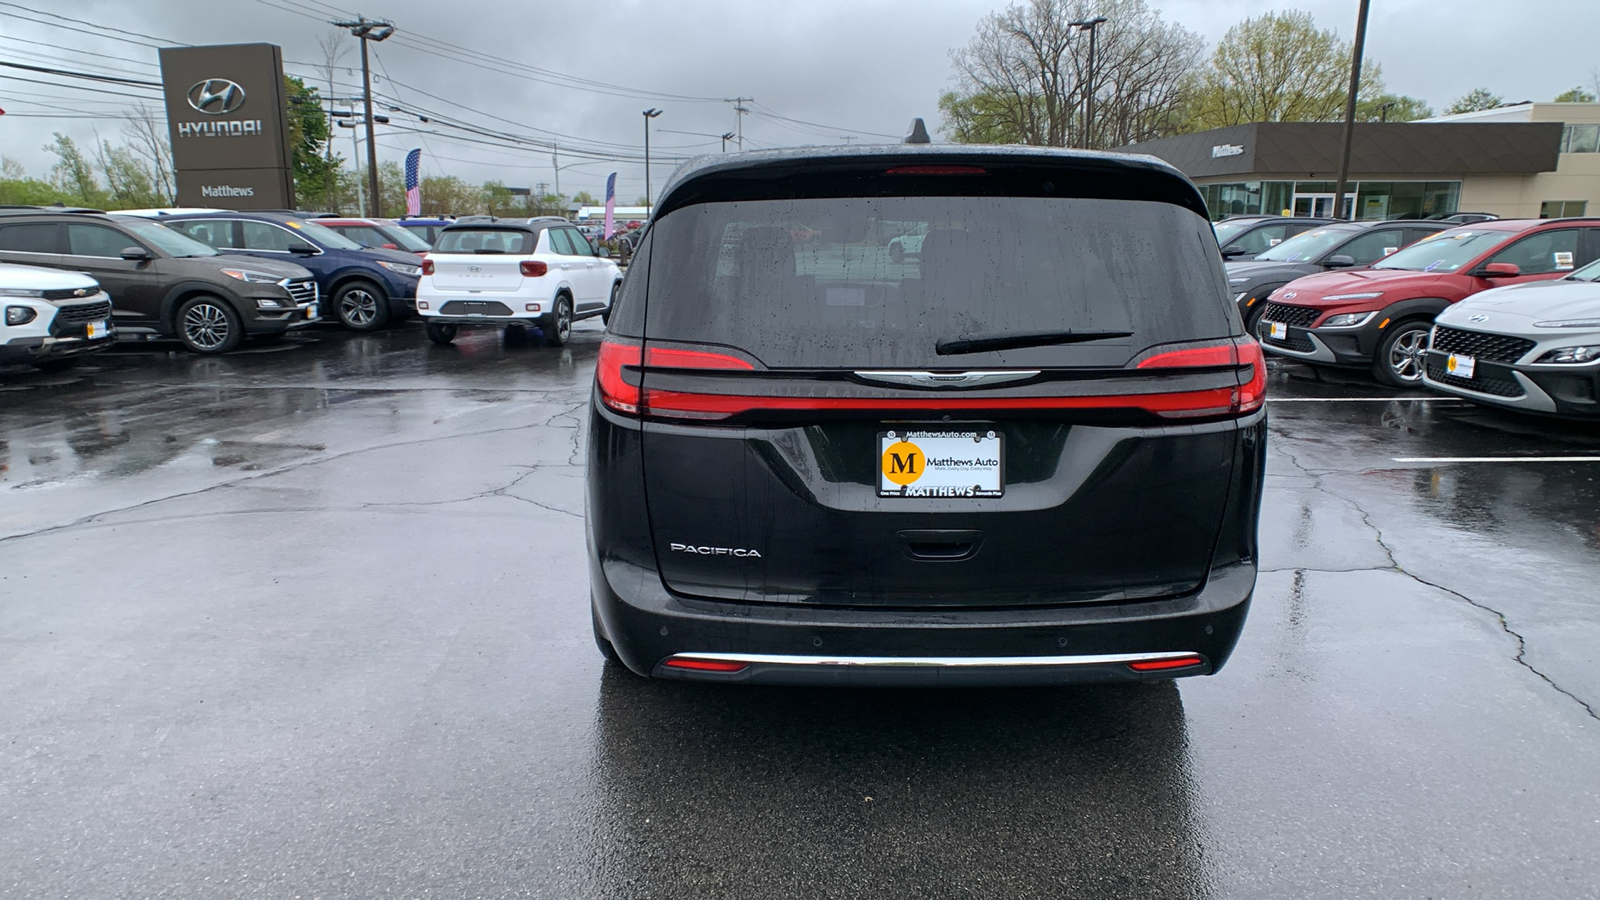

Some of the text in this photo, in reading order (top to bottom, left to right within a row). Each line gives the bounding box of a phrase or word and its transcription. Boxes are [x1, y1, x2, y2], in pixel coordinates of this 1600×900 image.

[178, 120, 262, 137] HYUNDAI
[201, 185, 254, 197] Matthews
[889, 453, 917, 474] M
[926, 457, 999, 467] Matthews Auto
[905, 486, 974, 497] MATTHEWS
[670, 543, 761, 557] PACIFICA
